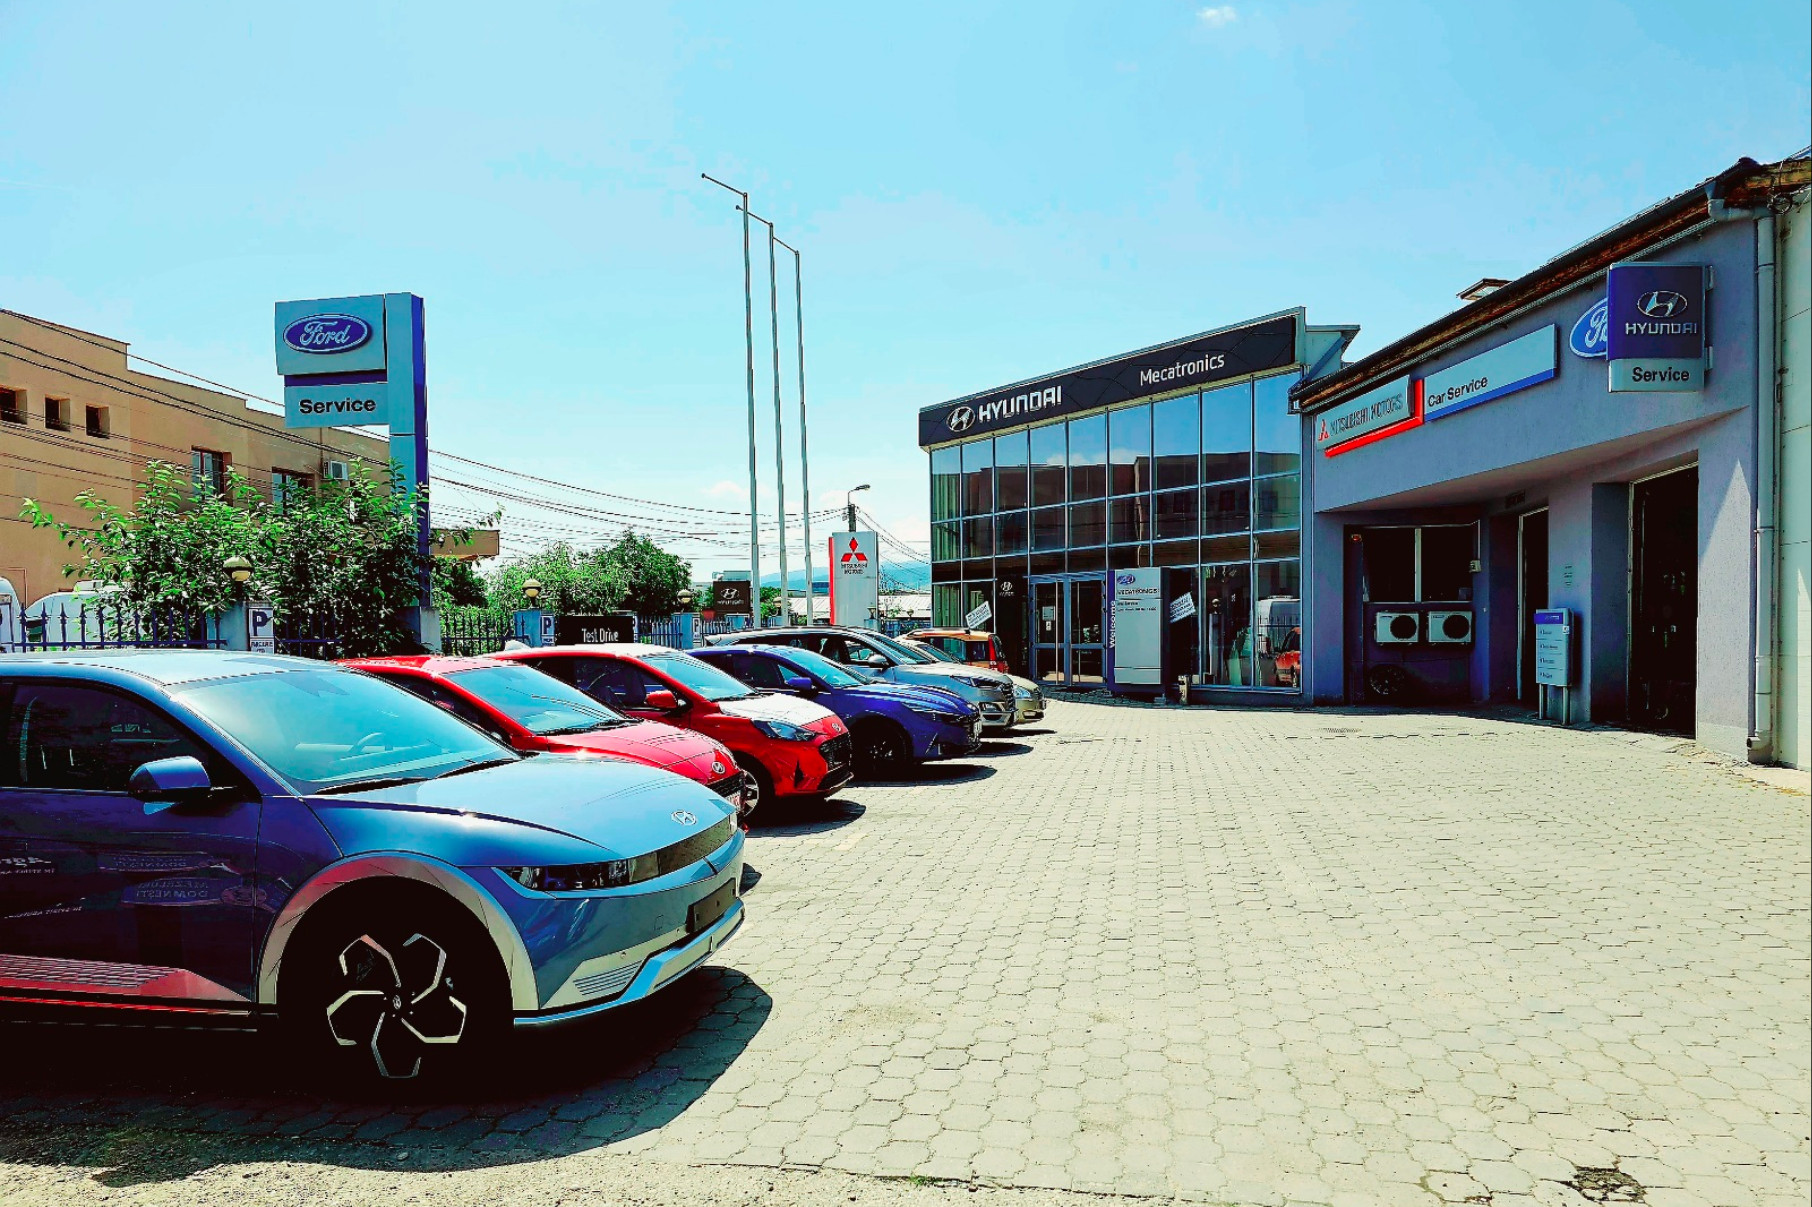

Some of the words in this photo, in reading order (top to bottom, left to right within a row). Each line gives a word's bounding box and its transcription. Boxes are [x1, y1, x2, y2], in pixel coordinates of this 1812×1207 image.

[299, 320, 351, 346] Ford
[1625, 322, 1697, 335] HYUNDAI
[1139, 353, 1225, 386] Mecatronics
[1632, 366, 1690, 382] Service
[1428, 390, 1446, 408] Car
[1447, 375, 1488, 401] Service
[299, 397, 376, 415] Service
[978, 385, 1062, 423] HYUNDAI
[252, 611, 268, 637] P
[543, 617, 552, 635] P
[581, 628, 599, 643] Test
[599, 627, 619, 642] Drive
